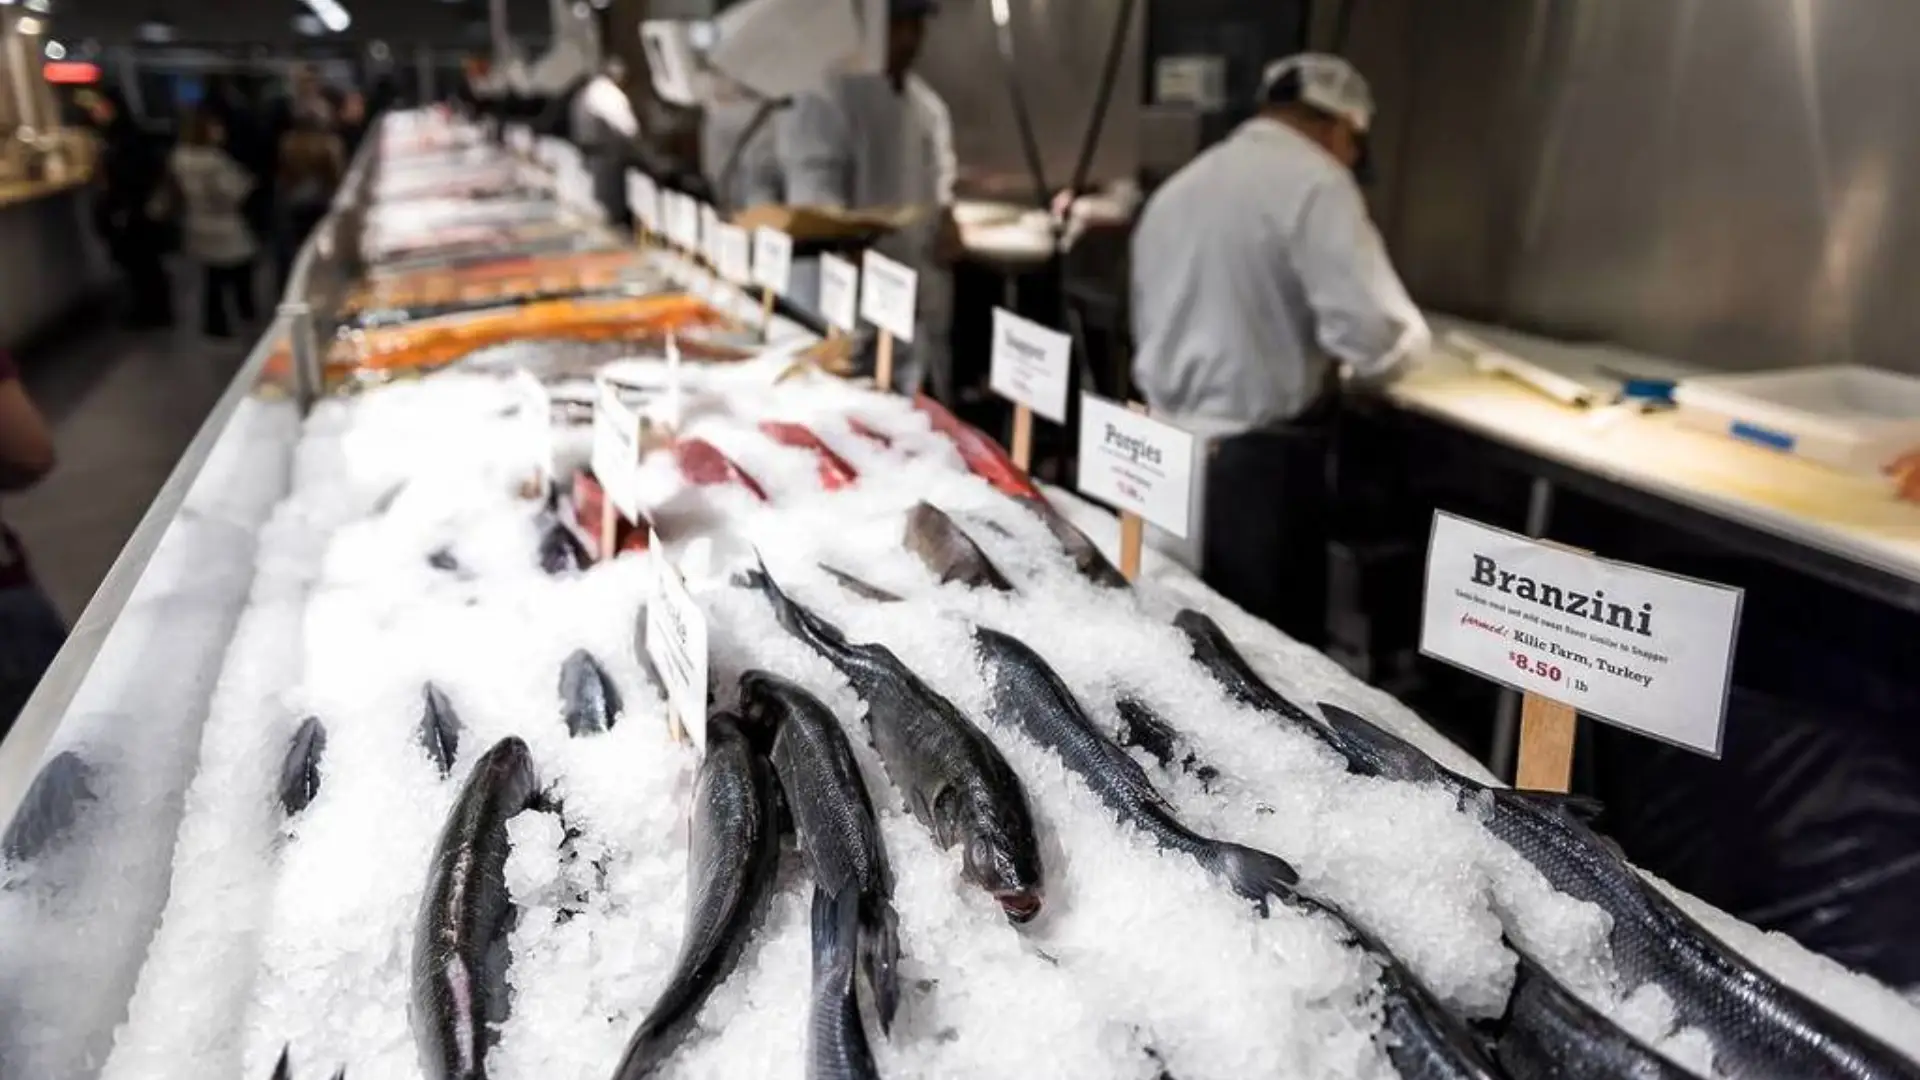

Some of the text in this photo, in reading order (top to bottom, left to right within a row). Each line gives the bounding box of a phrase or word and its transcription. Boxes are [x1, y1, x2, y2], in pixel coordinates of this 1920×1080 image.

[1471, 553, 1652, 636] Branzini
[1508, 650, 1563, 682] $8.50
[1574, 678, 1589, 692] lb
[1513, 630, 1547, 651] Kilic
[1549, 642, 1593, 668] Farm,
[1596, 657, 1654, 687] Turkey
